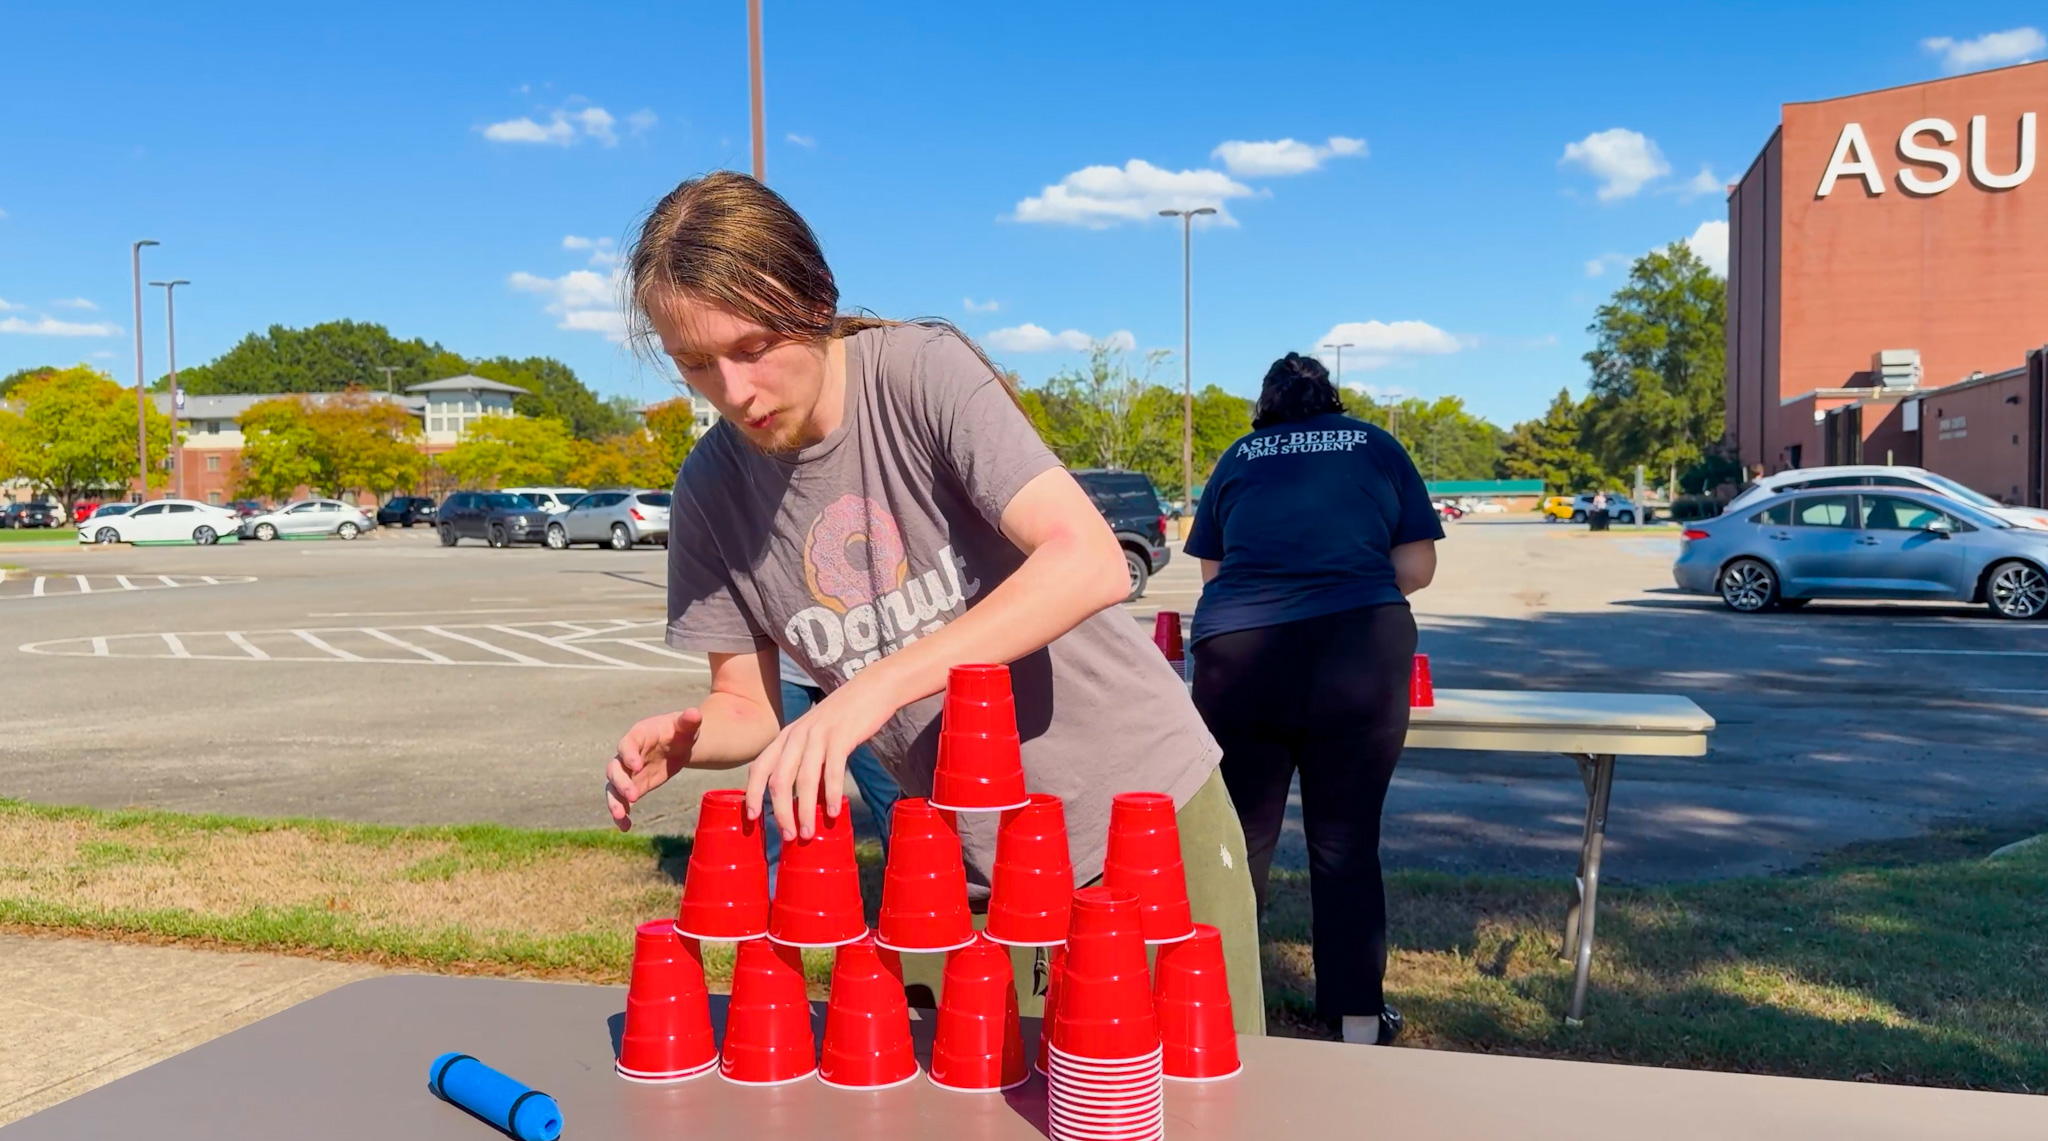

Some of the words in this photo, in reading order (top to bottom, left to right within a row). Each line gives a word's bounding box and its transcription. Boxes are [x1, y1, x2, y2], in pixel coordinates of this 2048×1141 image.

[1816, 111, 2037, 197] ASU
[1236, 430, 1368, 457] ASU-BEEBE
[1247, 447, 1278, 461] EMS
[1281, 442, 1356, 454] STUDENT
[785, 544, 981, 669] Donut
